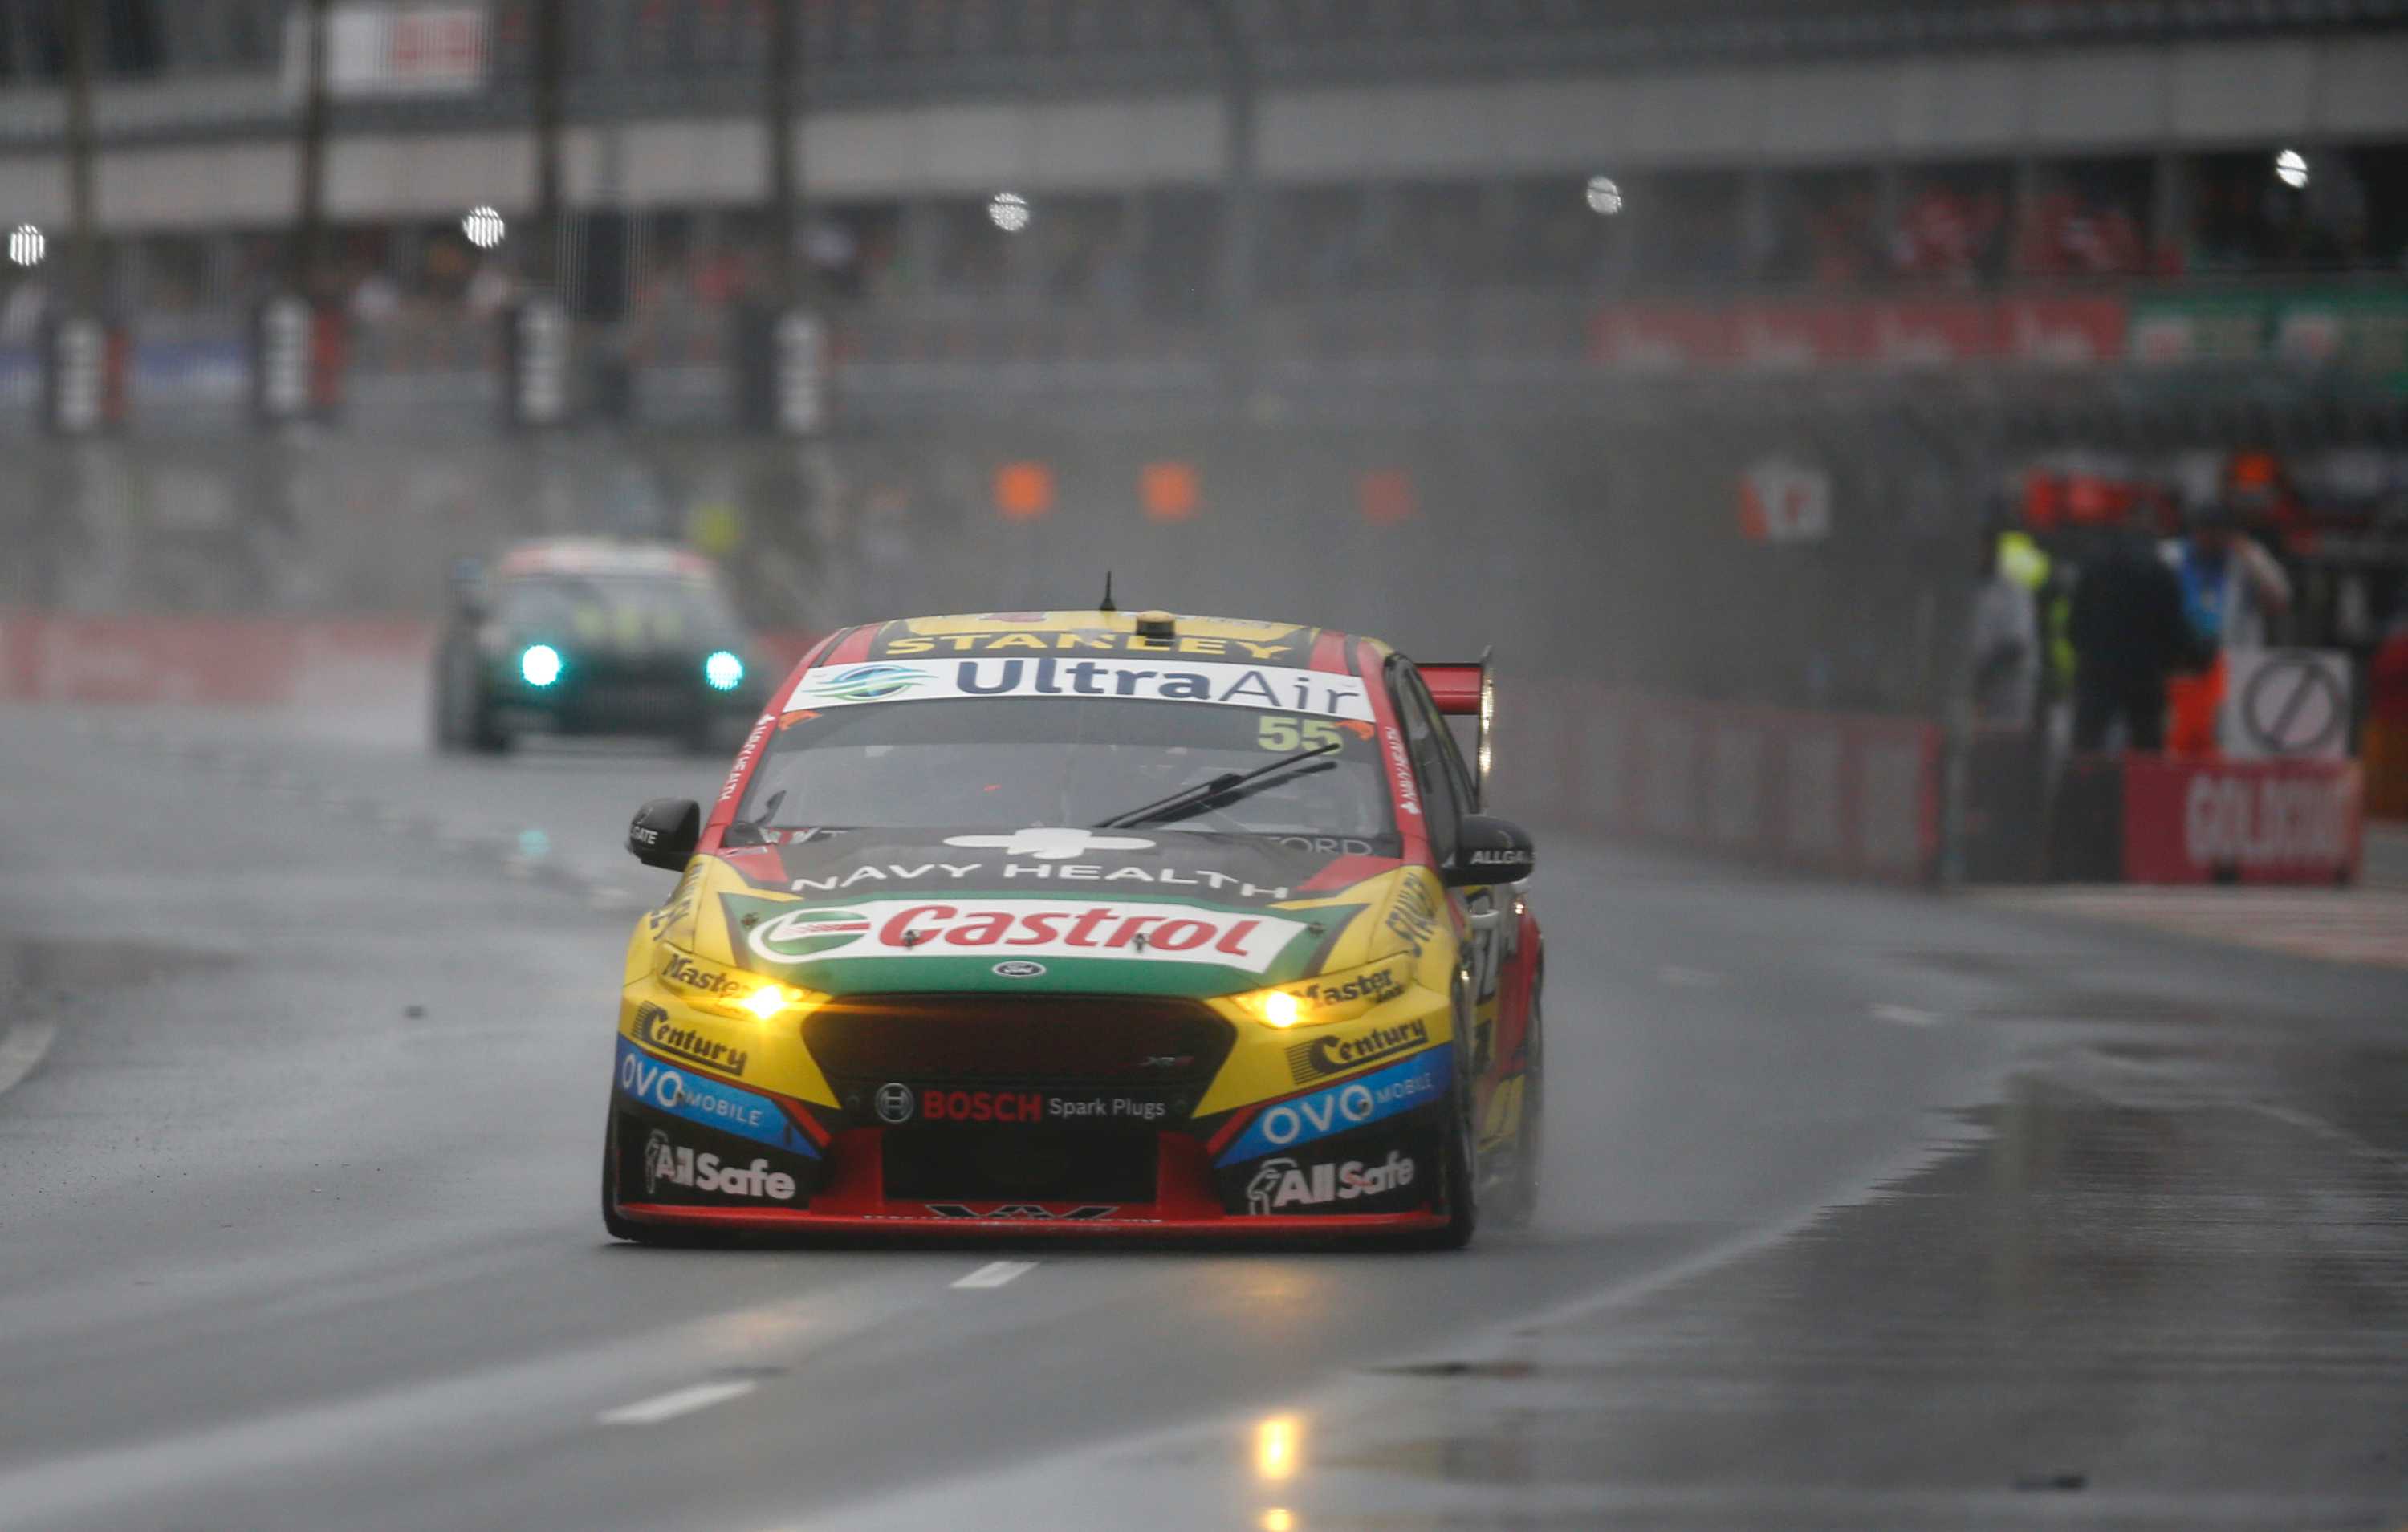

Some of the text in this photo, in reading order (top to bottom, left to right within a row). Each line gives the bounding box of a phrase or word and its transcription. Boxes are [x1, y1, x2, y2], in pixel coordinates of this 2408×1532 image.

[885, 632, 1293, 660] STANLEY
[956, 658, 1362, 714] UltraAir
[1257, 715, 1345, 756] 55
[1267, 836, 1373, 856] ORD
[1470, 851, 1536, 864] ALLGA
[790, 864, 1289, 900] NAVY HEALTH
[880, 905, 1260, 957] Castrol
[661, 953, 748, 996] Maste
[641, 1007, 748, 1074] Century
[1309, 1018, 1429, 1073] Century
[622, 1053, 763, 1127] OVO MOBILE
[922, 1091, 1167, 1122] BOSCH Spark Plugs
[1262, 1084, 1373, 1144] OVO
